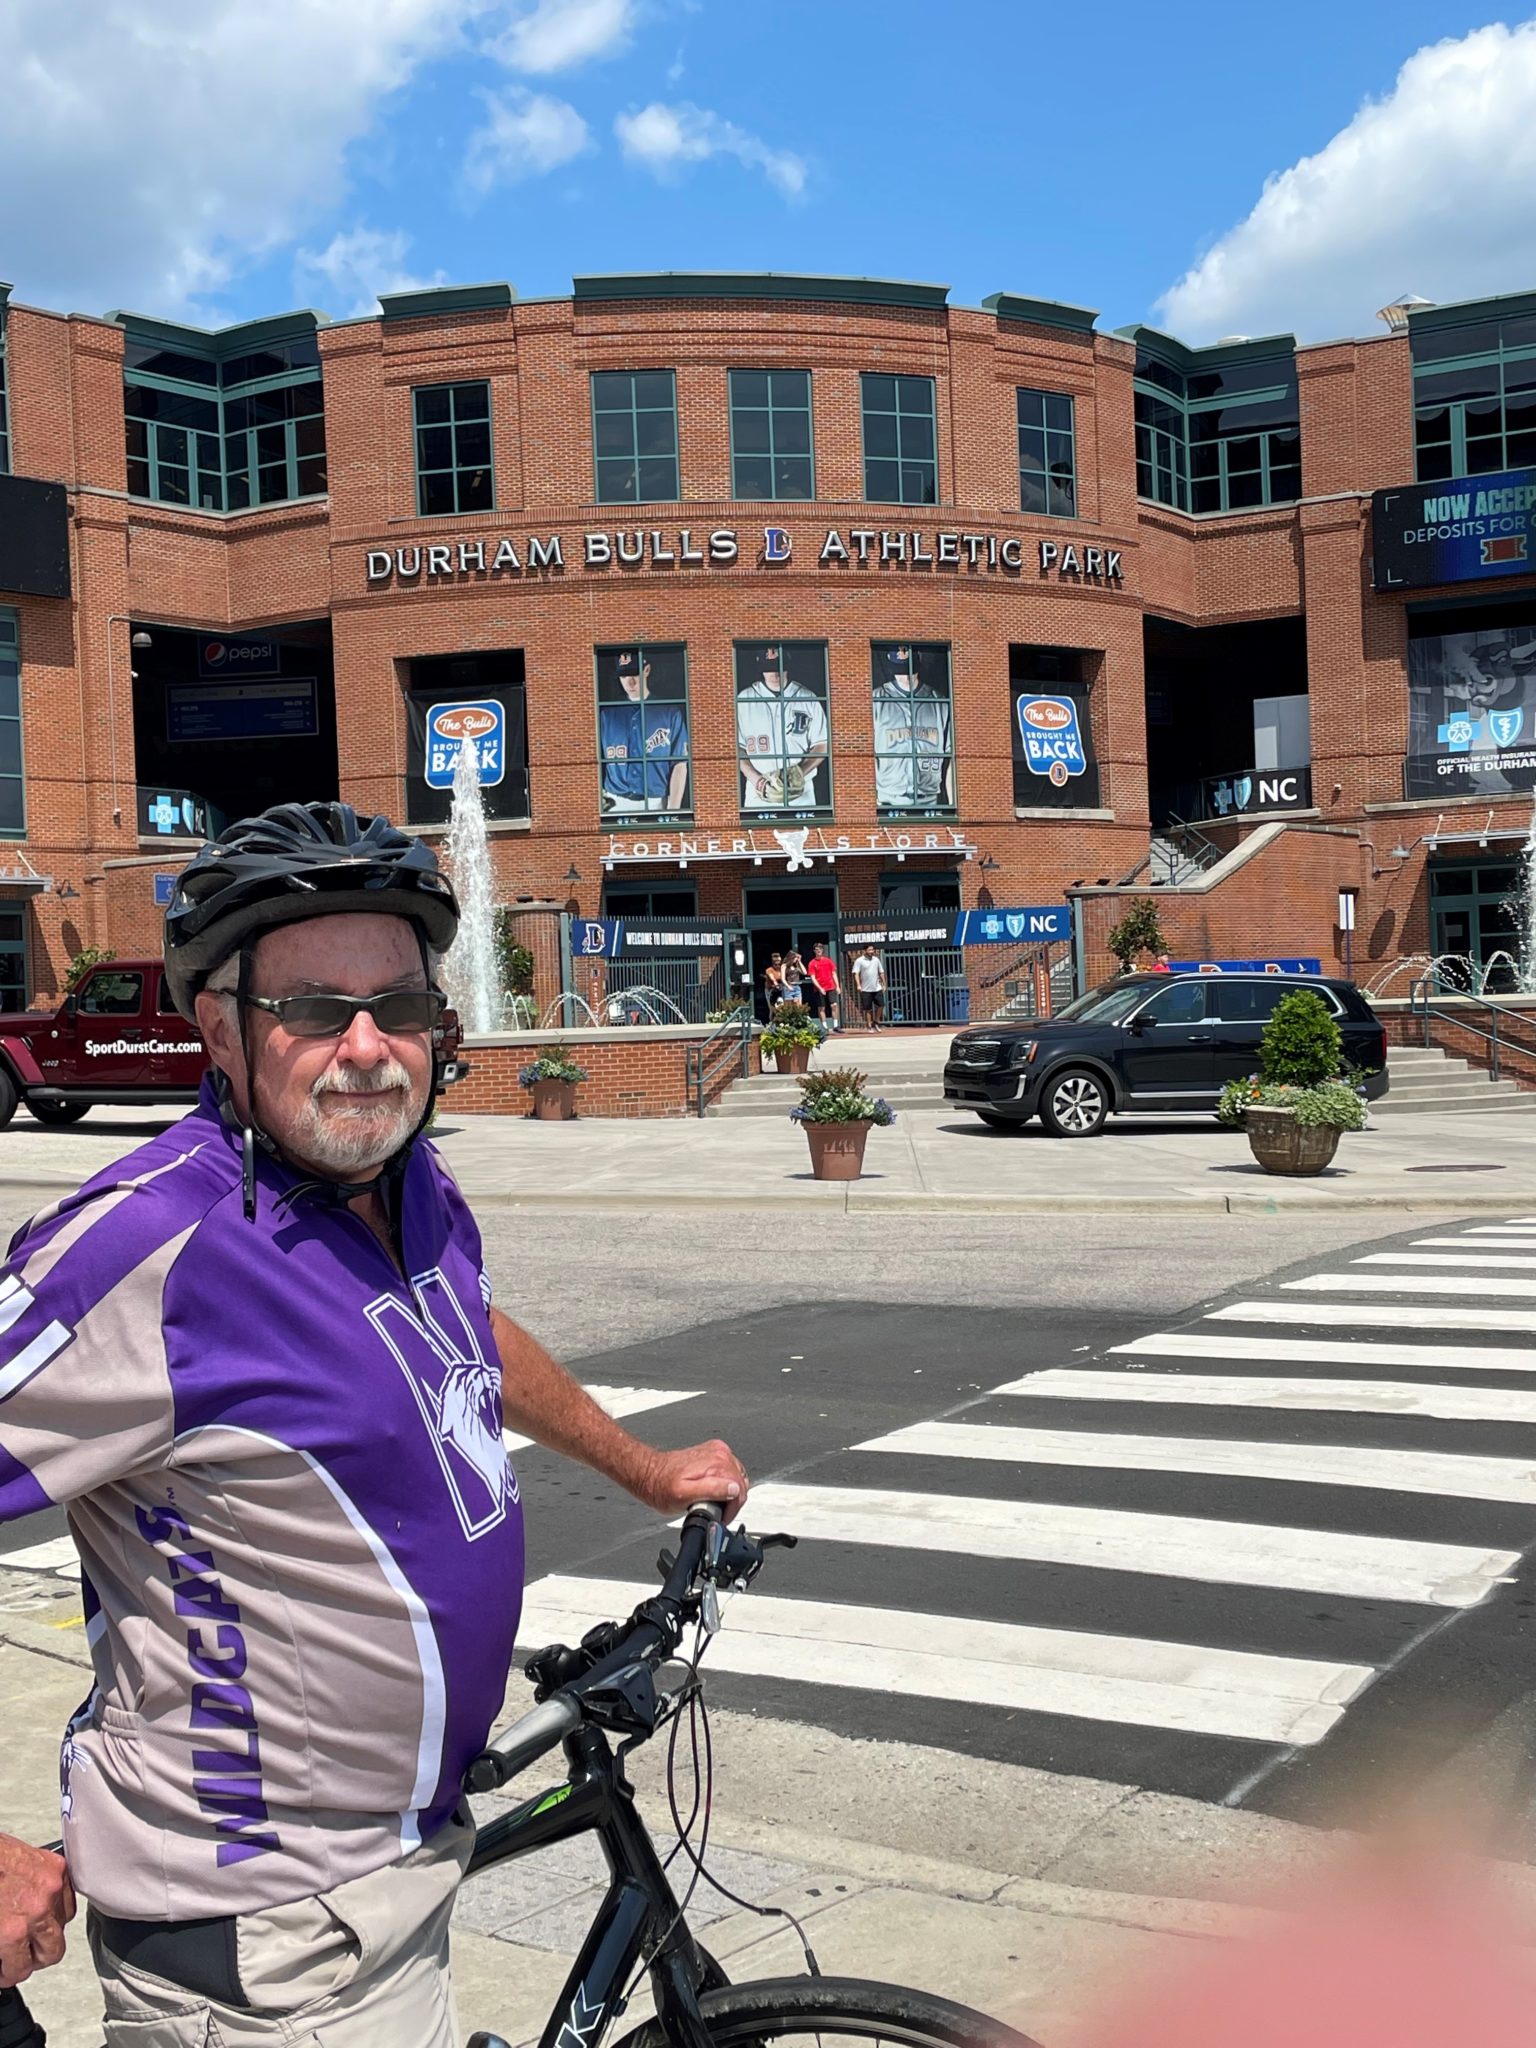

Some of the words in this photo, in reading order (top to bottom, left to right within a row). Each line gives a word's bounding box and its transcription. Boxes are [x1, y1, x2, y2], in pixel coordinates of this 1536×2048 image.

[1424, 494, 1470, 523] NOW
[1475, 486, 1536, 517] ACCEP
[1404, 521, 1485, 544] DEPOSITS
[1490, 515, 1526, 533] FOR
[367, 536, 564, 580] DURHAM
[585, 530, 738, 563] BULLS
[820, 530, 1022, 568] ATHLETIC
[1040, 540, 1123, 578] PARK
[229, 644, 272, 662] pepsi
[440, 718, 461, 731] The
[463, 716, 492, 730] Bulls
[1027, 709, 1044, 721] The
[1045, 709, 1068, 722] Bulls
[433, 740, 480, 751] BROUT
[484, 740, 498, 748] ME
[746, 735, 769, 753] 29
[1026, 732, 1062, 740] BROUGHT
[1065, 733, 1076, 741] ME
[1028, 740, 1080, 760] BACK
[432, 749, 498, 772] BAK
[1437, 757, 1470, 765] OFFICIAL
[1437, 765, 1454, 775] OF
[1457, 763, 1481, 773] THE
[1259, 778, 1297, 803] NC
[609, 838, 747, 857] CORNER
[837, 833, 968, 850] STORE
[1030, 915, 1058, 933] NC
[888, 931, 903, 942] CUP
[904, 928, 947, 940] CHAMPIONS
[85, 1039, 202, 1057] SportDurstCars.com
[134, 1503, 283, 1868] WILDCATS
